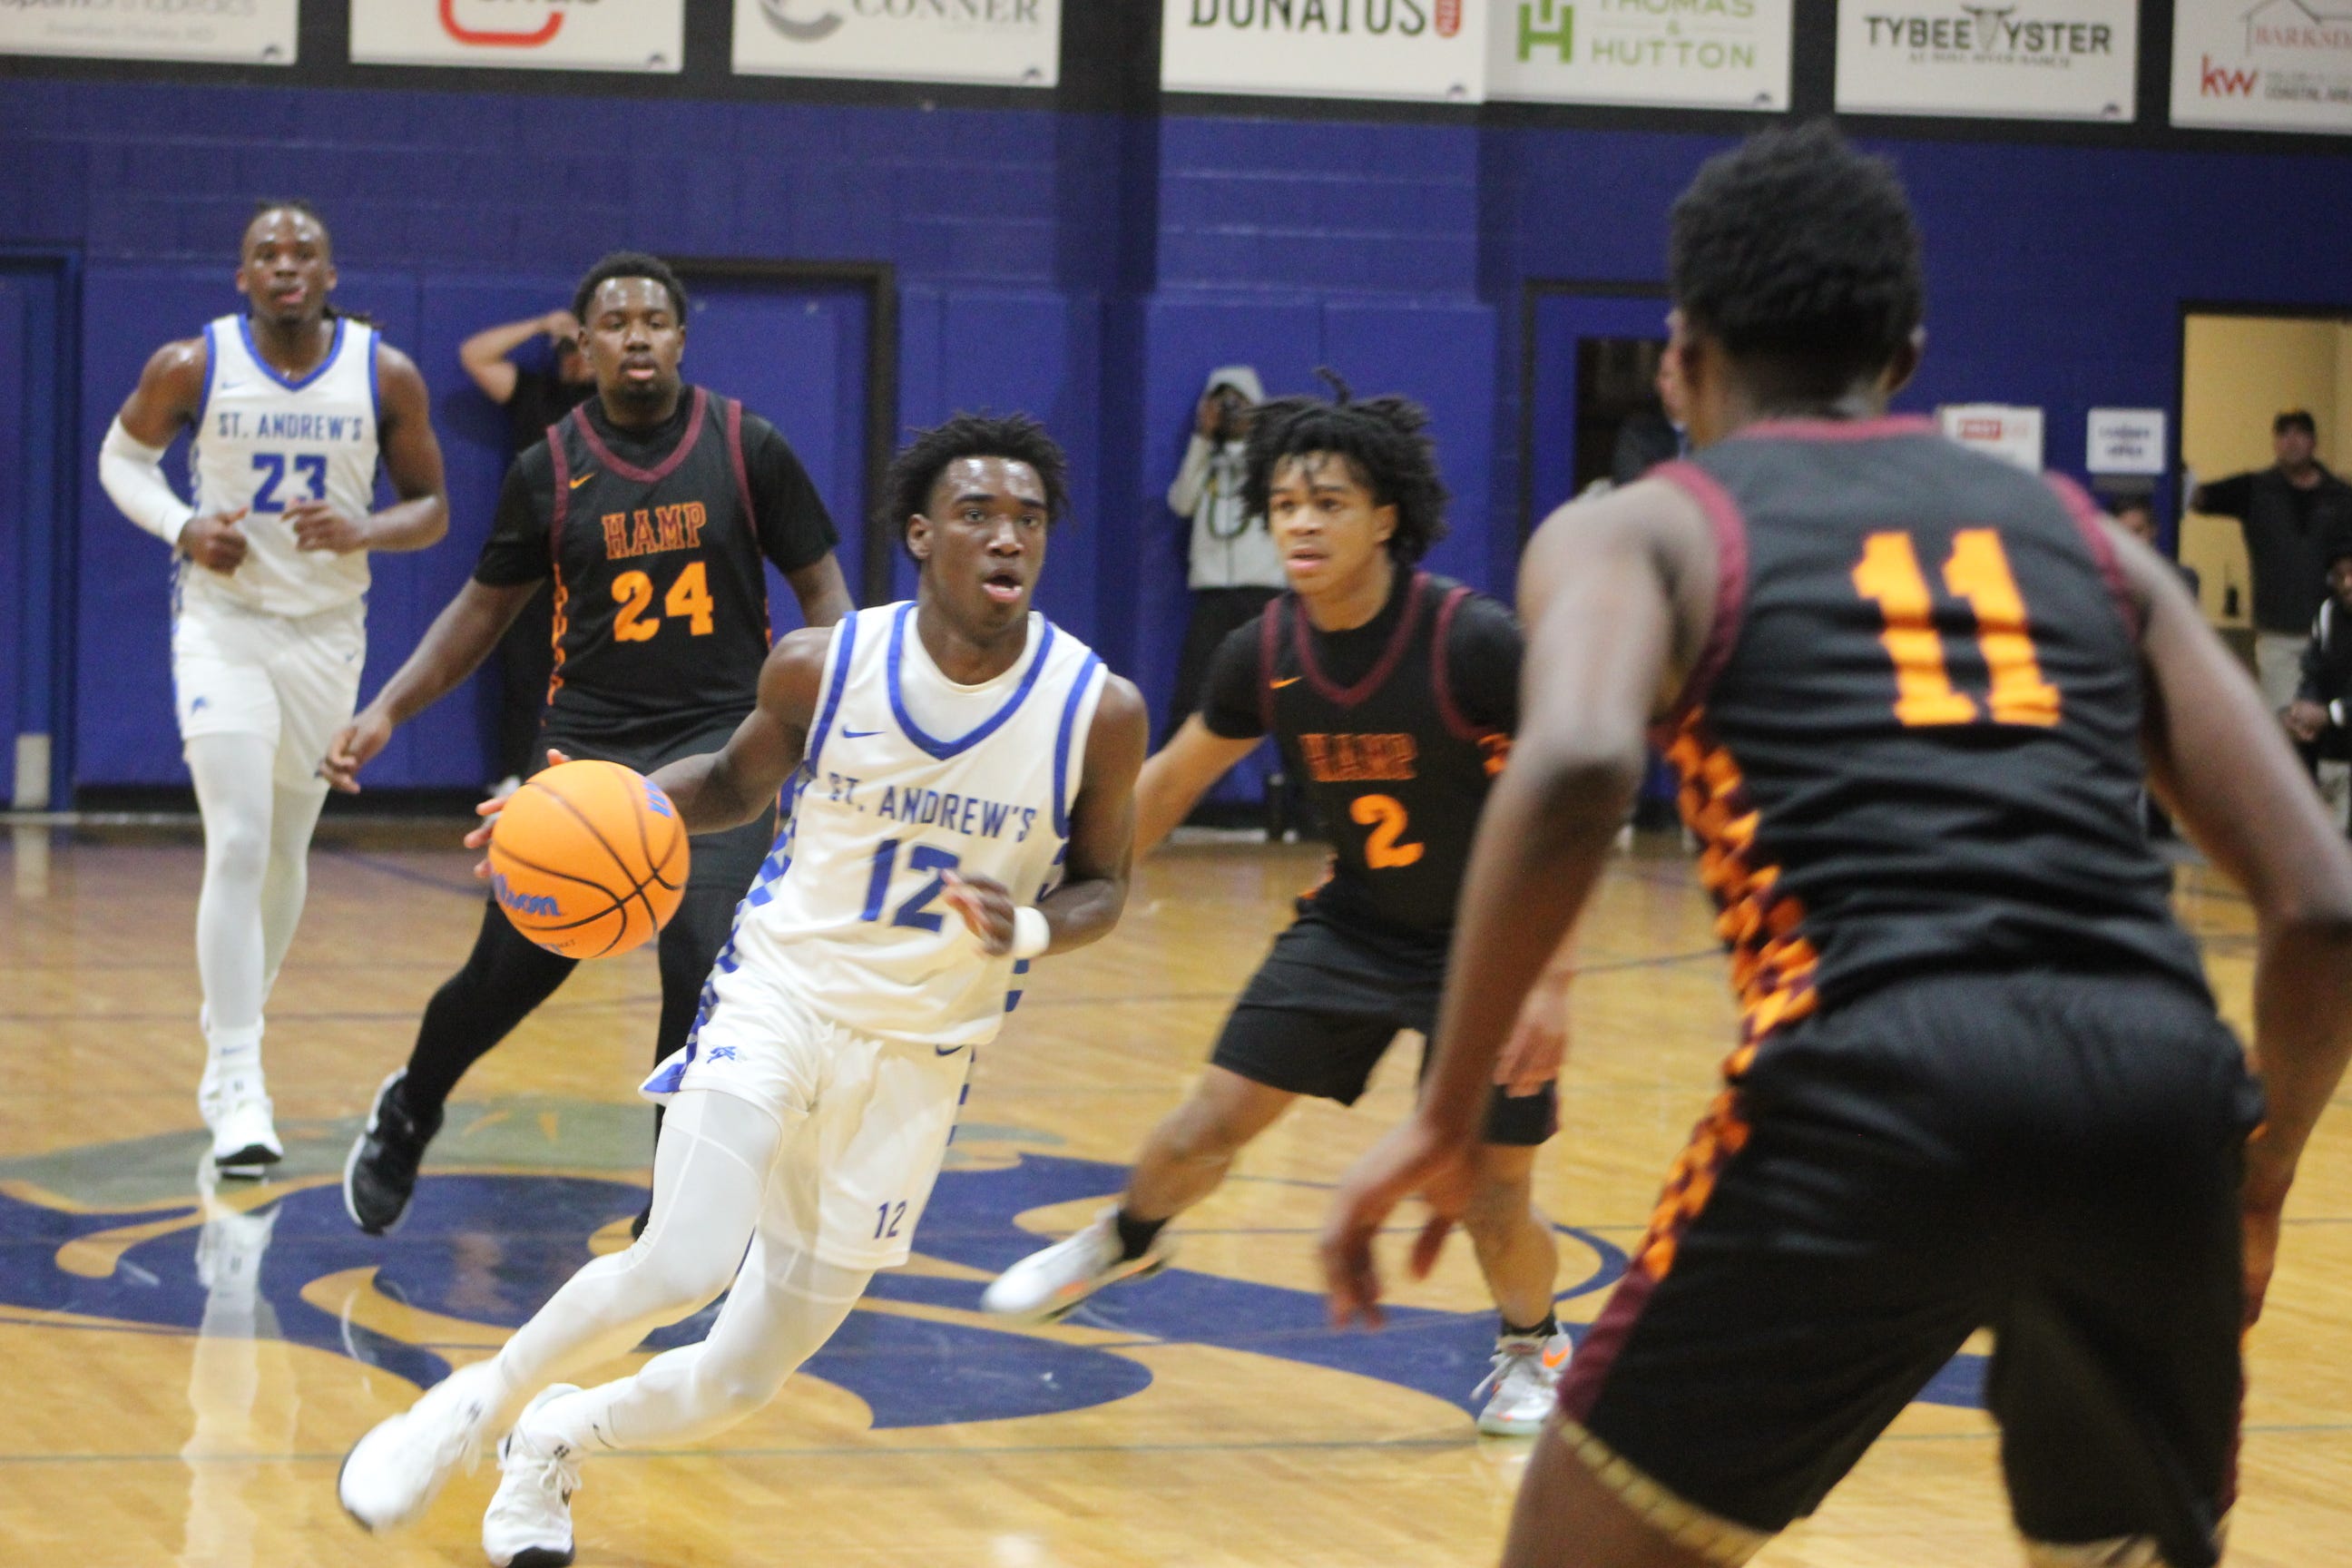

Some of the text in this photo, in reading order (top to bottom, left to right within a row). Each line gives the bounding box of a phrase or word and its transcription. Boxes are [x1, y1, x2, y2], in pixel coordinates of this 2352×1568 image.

[1591, 38, 1755, 69] HUTTON
[1864, 16, 1972, 49] TYBEE
[2200, 52, 2259, 97] kw
[219, 412, 363, 441] ST. ANDREW'S
[251, 453, 328, 513] 23
[601, 501, 708, 561] HAMP
[611, 561, 714, 642] 24
[1850, 527, 2063, 727] 11
[828, 772, 1038, 843] ST. ANDREW'S
[1349, 793, 1425, 869] 2
[491, 873, 564, 917] lson
[859, 838, 961, 934] 12
[873, 1200, 907, 1240] 12
